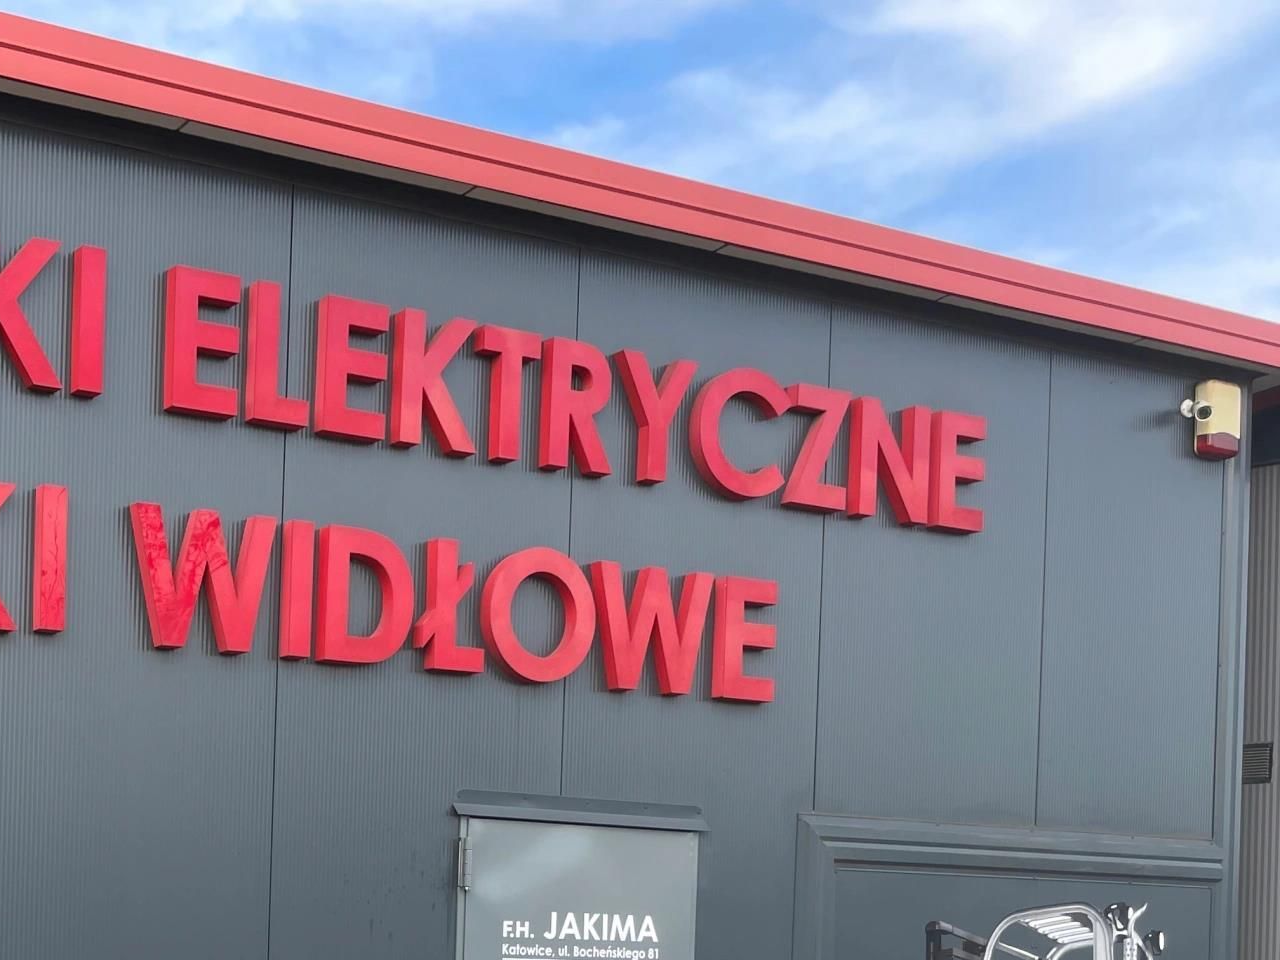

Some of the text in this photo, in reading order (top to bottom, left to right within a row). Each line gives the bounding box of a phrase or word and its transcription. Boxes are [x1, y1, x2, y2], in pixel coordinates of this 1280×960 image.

[163, 265, 987, 534] ELEKTRYCZNE
[130, 502, 777, 702] WIDŁOWE
[502, 911, 659, 942] F.H. JAKIMA
[558, 945, 570, 957] ul.
[573, 945, 645, 960] Bocheńskiego
[648, 948, 659, 959] 81
